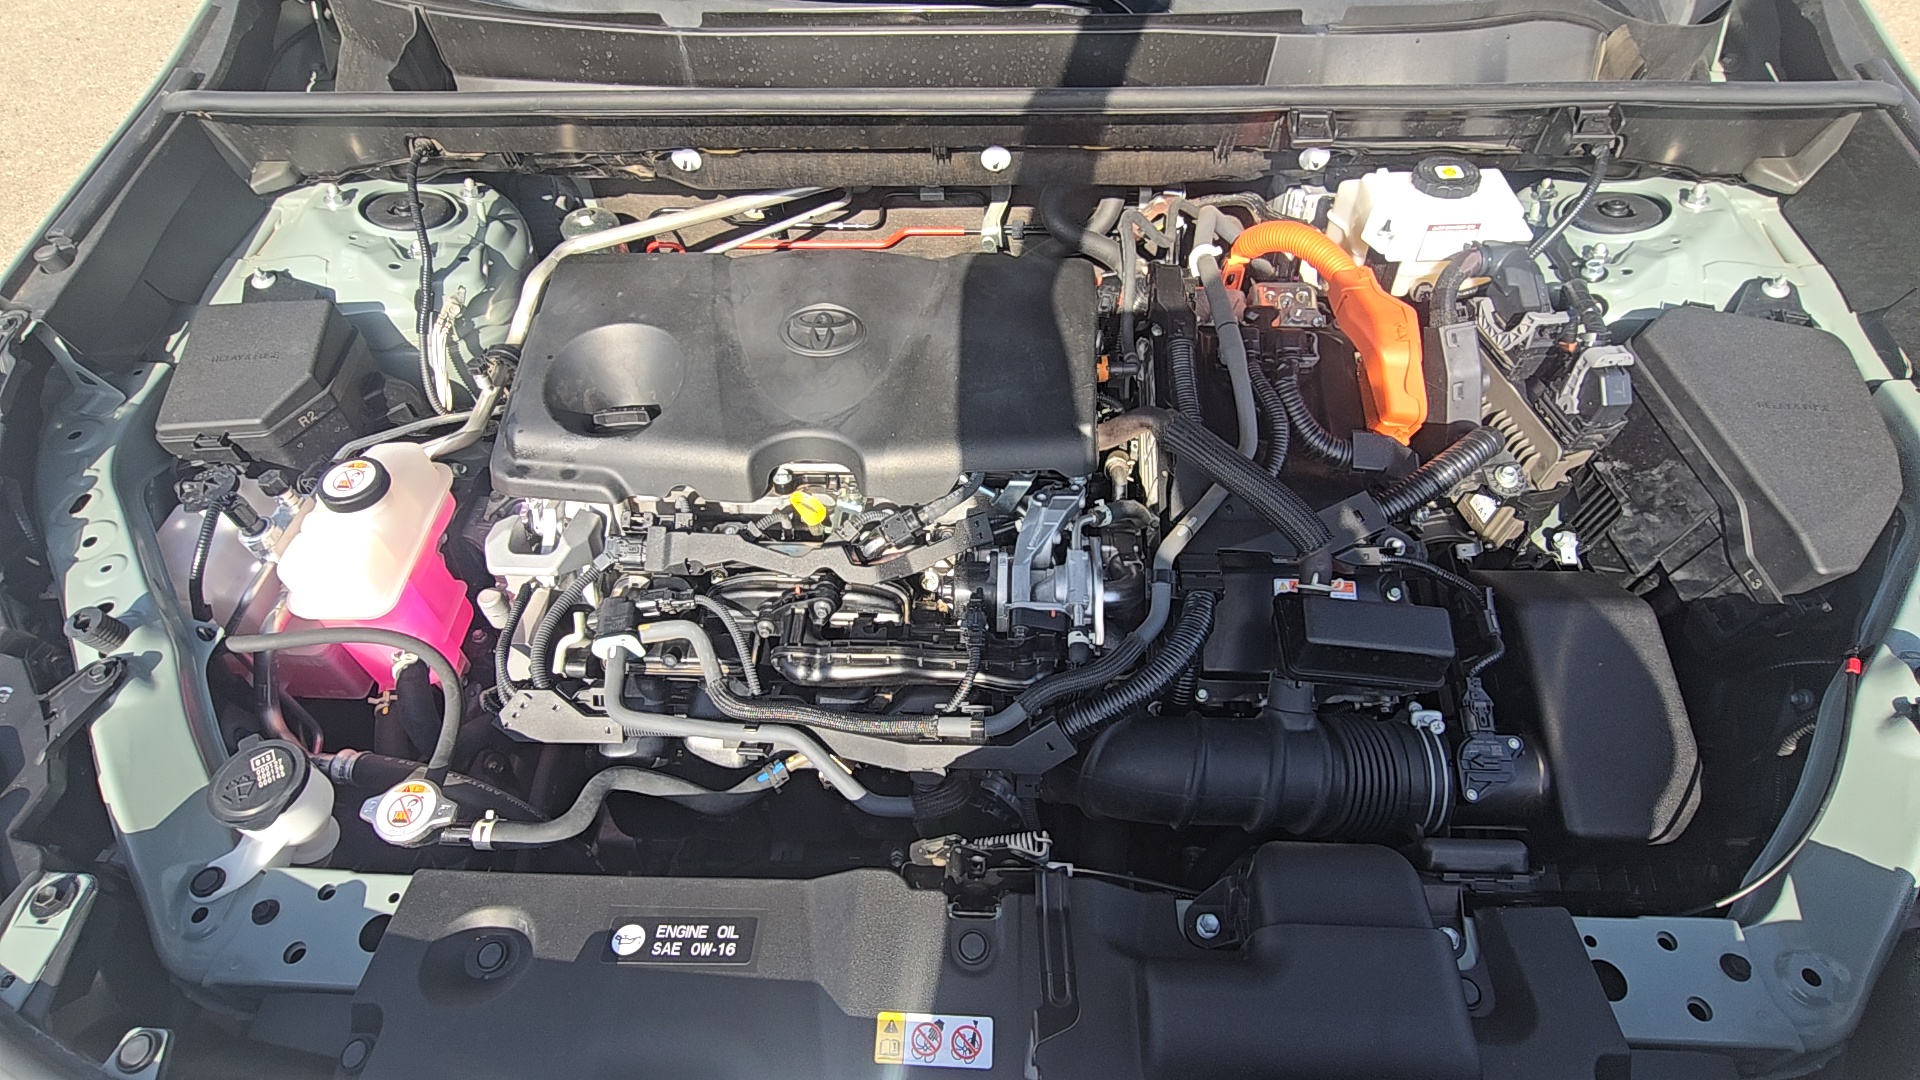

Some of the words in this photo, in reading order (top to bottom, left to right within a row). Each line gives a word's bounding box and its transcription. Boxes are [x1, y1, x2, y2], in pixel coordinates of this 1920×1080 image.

[297, 410, 319, 428] R2
[1743, 568, 1763, 590] L3
[655, 924, 710, 939] ENGINE
[716, 925, 740, 939] OIL
[651, 941, 683, 956] SAE
[690, 942, 737, 957] 0W-16
